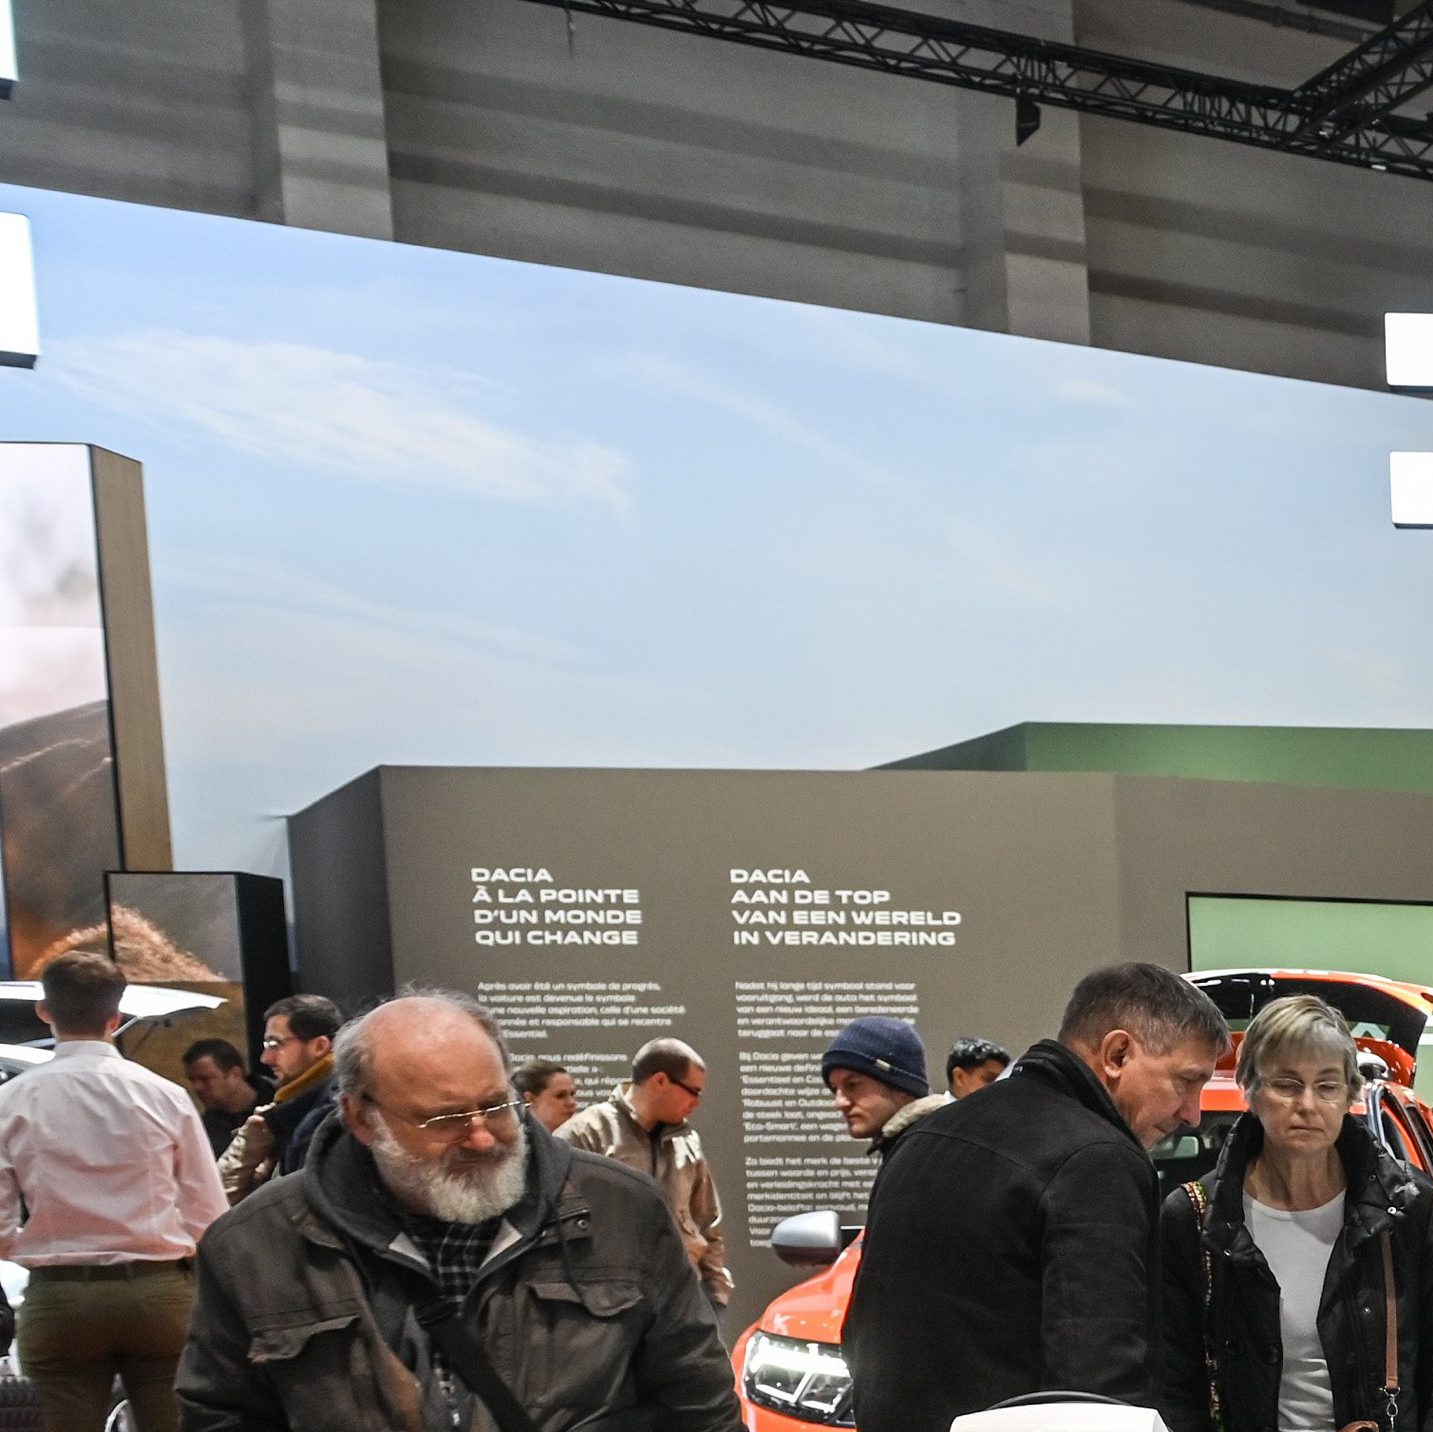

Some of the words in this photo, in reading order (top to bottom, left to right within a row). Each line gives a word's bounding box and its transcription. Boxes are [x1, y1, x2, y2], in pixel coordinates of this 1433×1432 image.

[471, 868, 553, 883] DACIA
[730, 869, 810, 883] DACIA
[473, 885, 492, 904] À
[498, 889, 536, 904] LA
[541, 889, 639, 904] POINTE
[731, 890, 790, 904] AAN
[794, 890, 830, 904] DE
[835, 890, 890, 904] TOP
[544, 910, 642, 924] MONDE
[732, 911, 788, 926] VAN
[793, 911, 846, 926] EEN
[852, 911, 961, 926] WERELD
[475, 930, 522, 947] QUI
[527, 930, 639, 945] CHANGE
[734, 931, 760, 946] IN
[765, 931, 956, 946] VERANDERING
